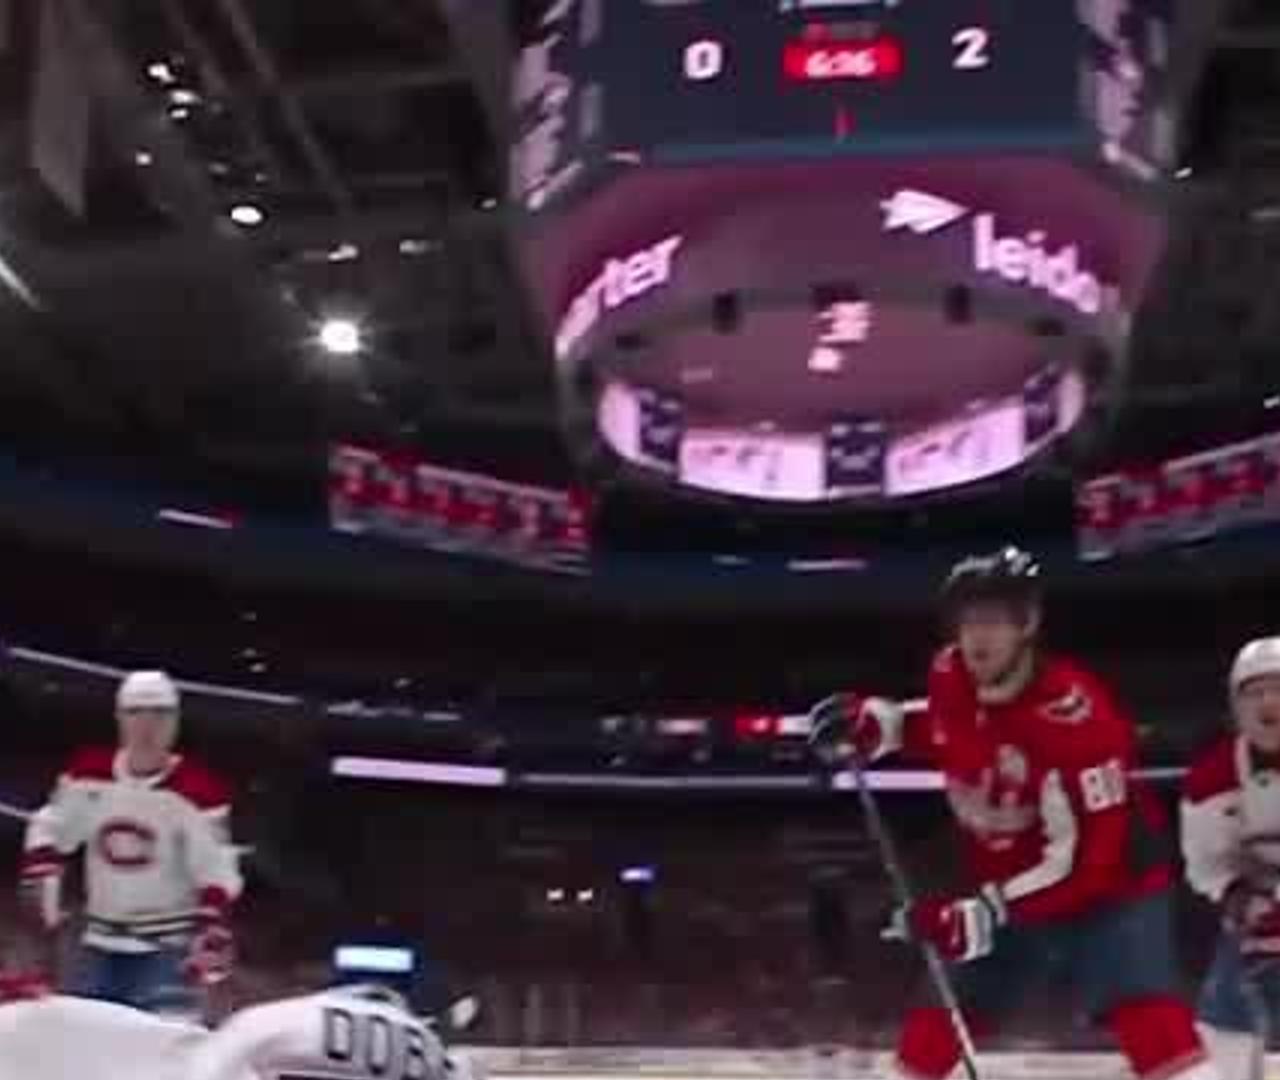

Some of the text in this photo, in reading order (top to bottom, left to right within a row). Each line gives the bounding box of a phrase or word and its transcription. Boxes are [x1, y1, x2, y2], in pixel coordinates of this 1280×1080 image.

[684, 41, 721, 79] 0
[951, 26, 989, 68] 2
[973, 212, 1104, 314] leido
